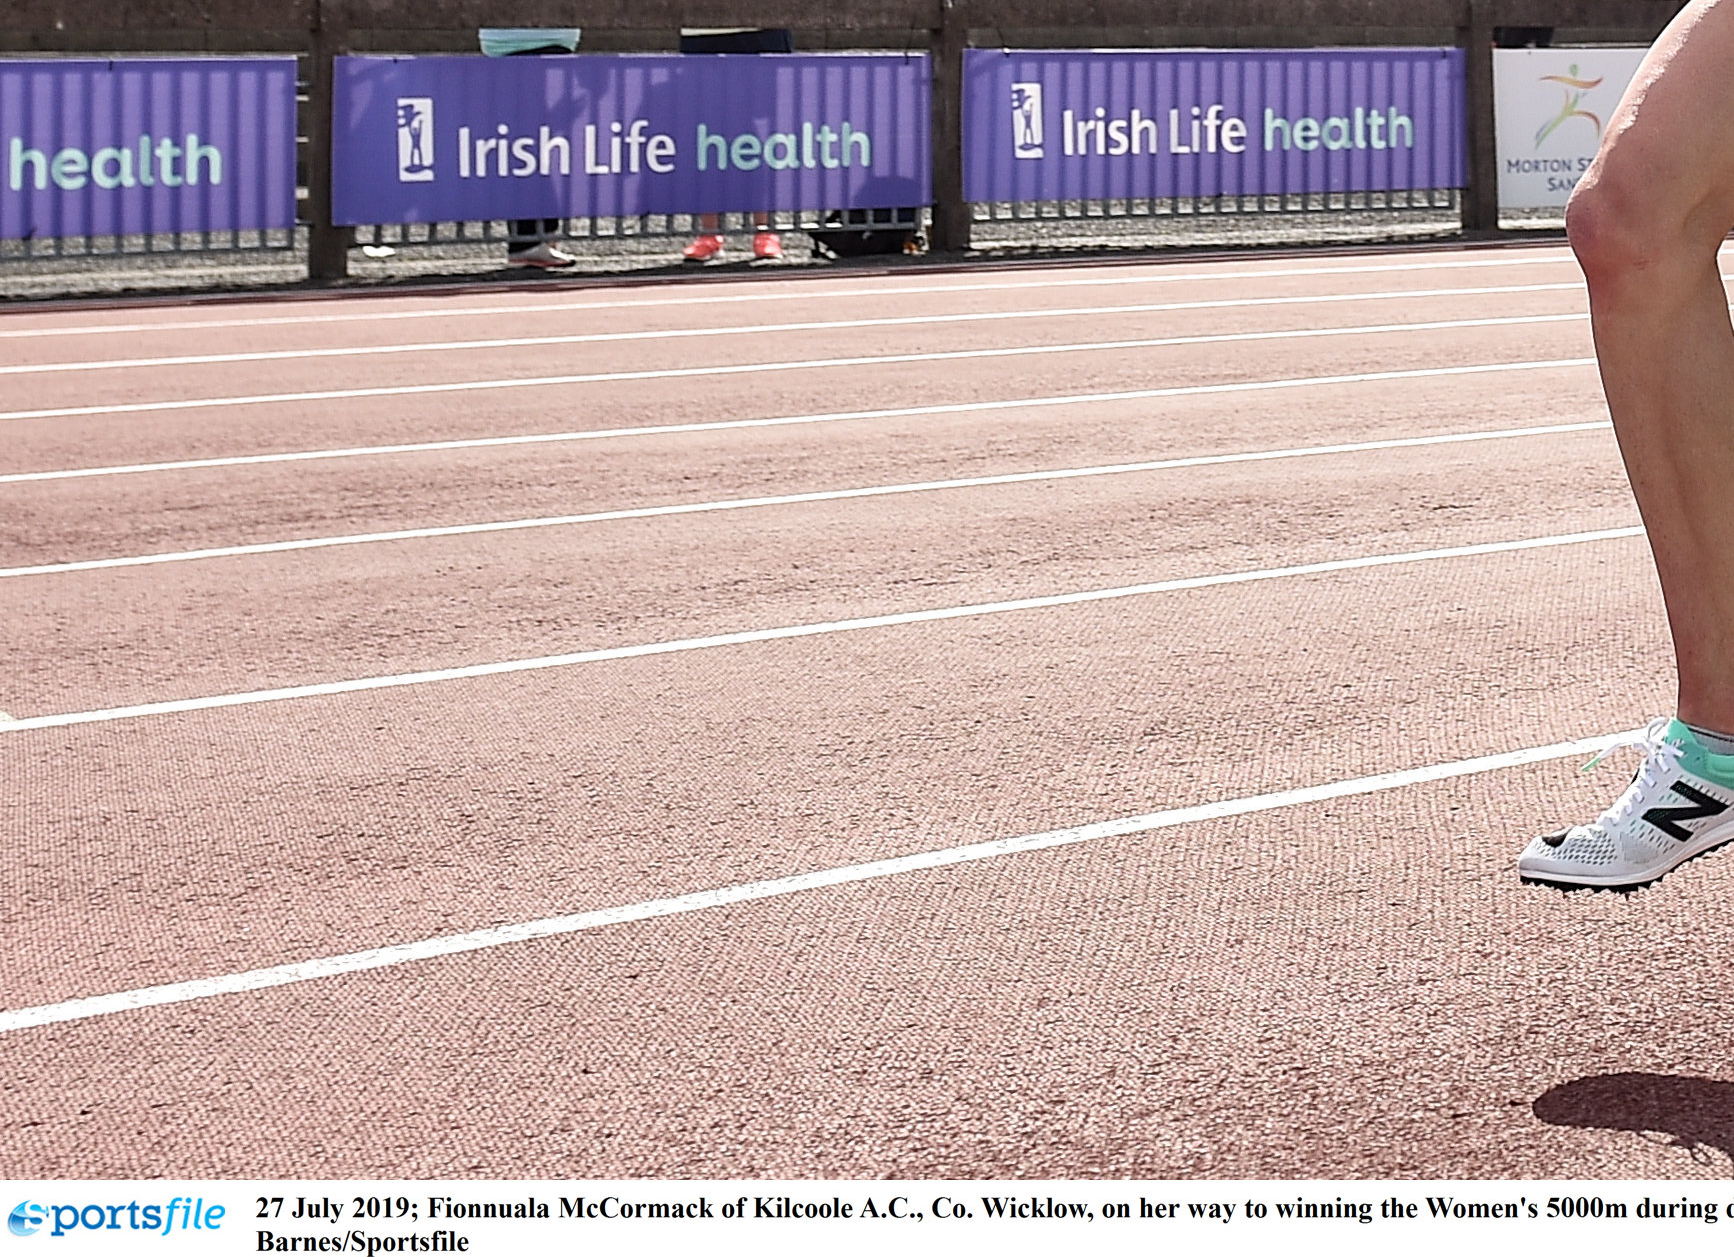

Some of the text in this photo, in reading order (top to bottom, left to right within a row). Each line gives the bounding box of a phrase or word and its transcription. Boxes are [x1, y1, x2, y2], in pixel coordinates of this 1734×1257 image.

[459, 120, 871, 177] Irish Life health
[1063, 105, 1414, 155] Irish Life health
[9, 133, 223, 191] health
[1507, 159, 1572, 173] MORTON
